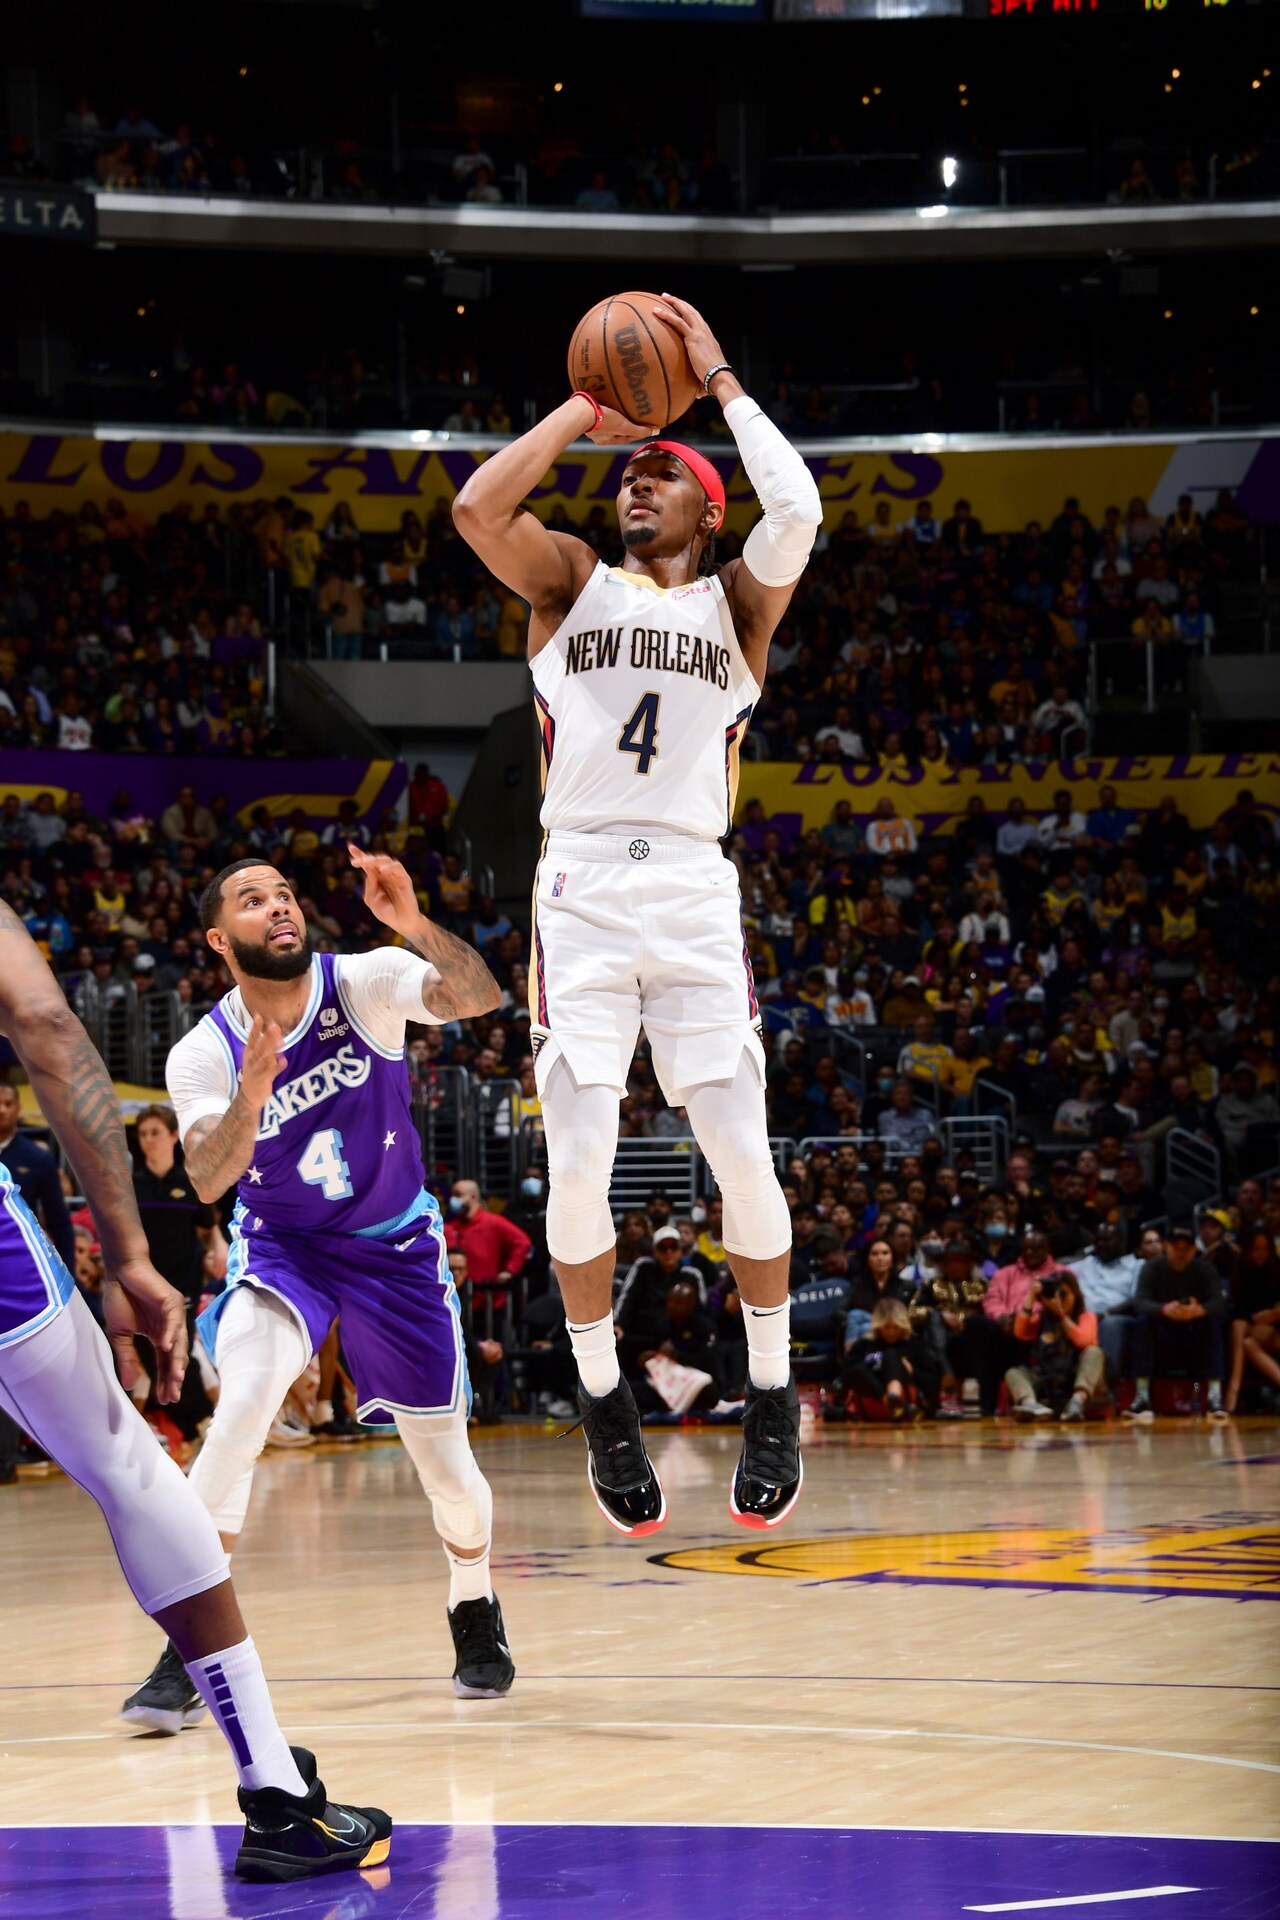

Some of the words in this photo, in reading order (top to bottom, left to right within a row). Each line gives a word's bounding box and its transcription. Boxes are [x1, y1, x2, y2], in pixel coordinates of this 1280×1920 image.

[7, 434, 264, 493] LOS
[565, 627, 624, 677] NEW
[630, 628, 731, 690] ORLEANS
[616, 690, 661, 777] 4
[939, 750, 1280, 784] ANGELE
[317, 1022, 350, 1042] bibigo
[296, 1127, 354, 1201] 4
